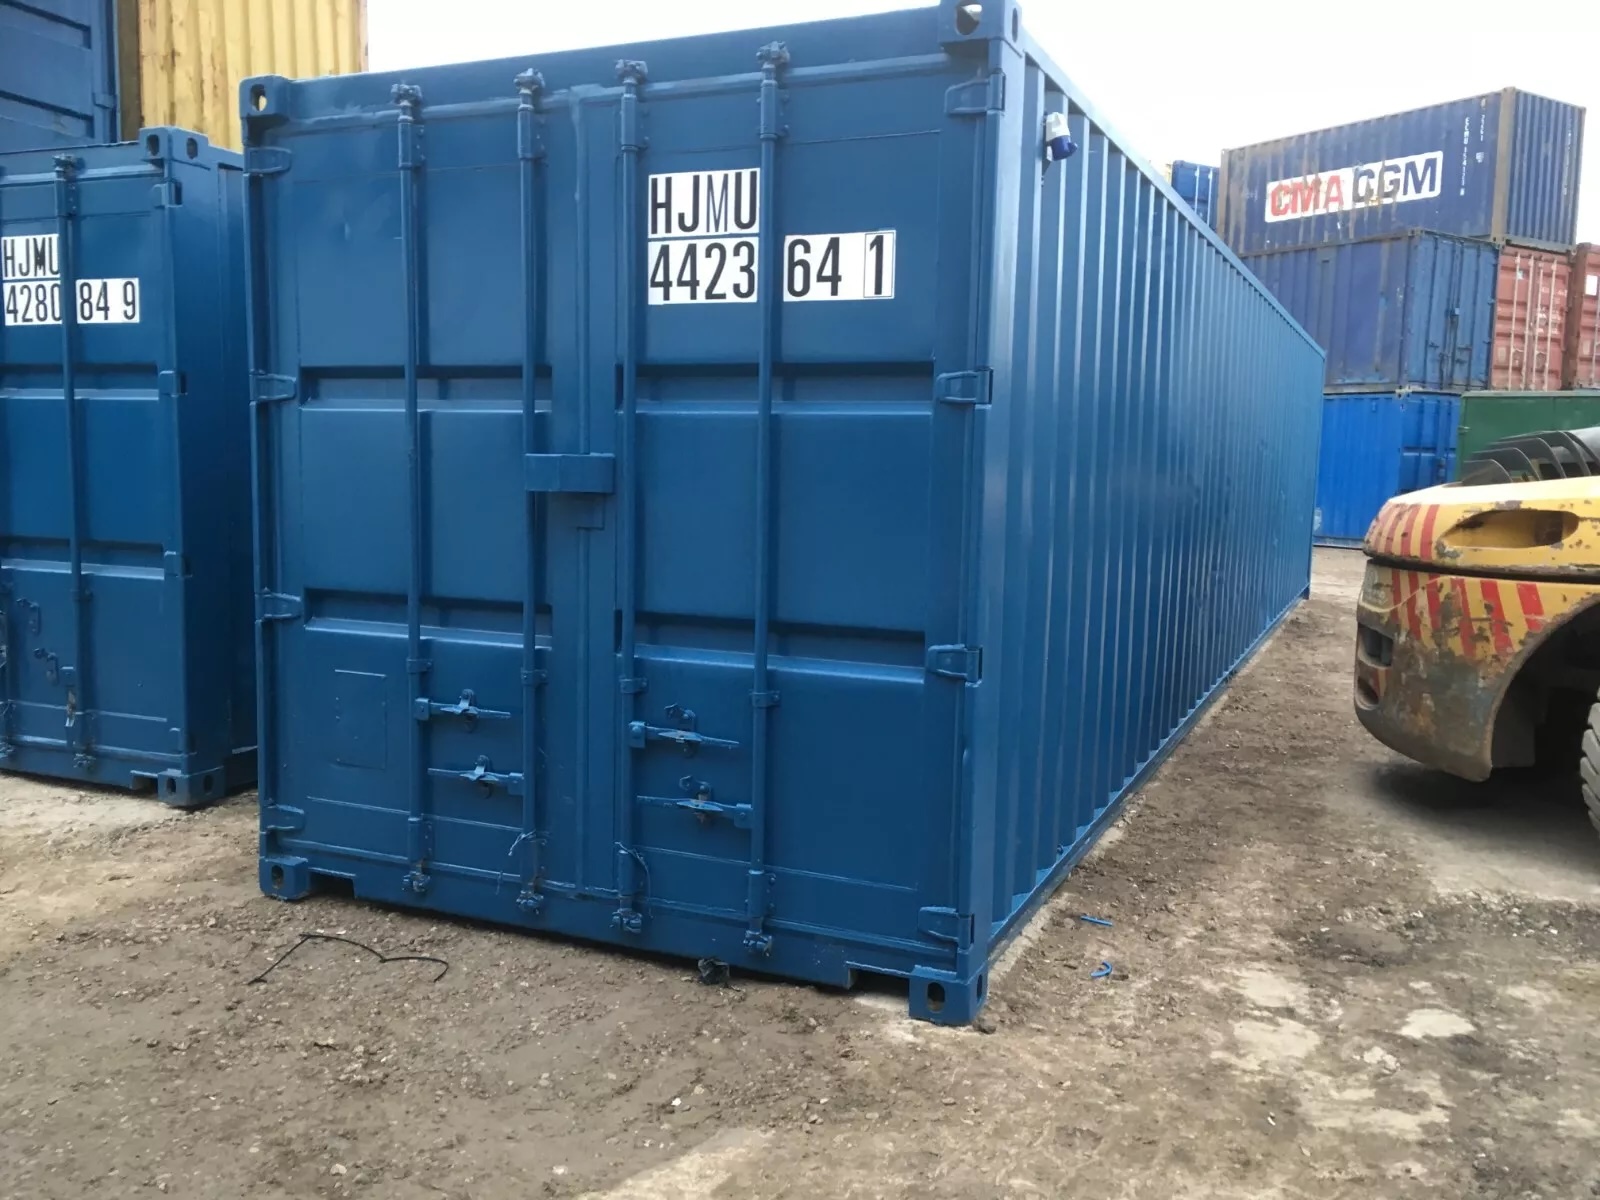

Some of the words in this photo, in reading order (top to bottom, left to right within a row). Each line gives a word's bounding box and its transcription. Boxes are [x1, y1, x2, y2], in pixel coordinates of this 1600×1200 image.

[650, 170, 758, 235] HJMU
[1271, 175, 1344, 217] CMA
[1352, 157, 1438, 203] CGM
[3, 236, 60, 278] HJMU
[649, 240, 756, 301] 4423
[787, 236, 842, 298] 64
[6, 283, 62, 323] 4280
[79, 281, 110, 321] 84
